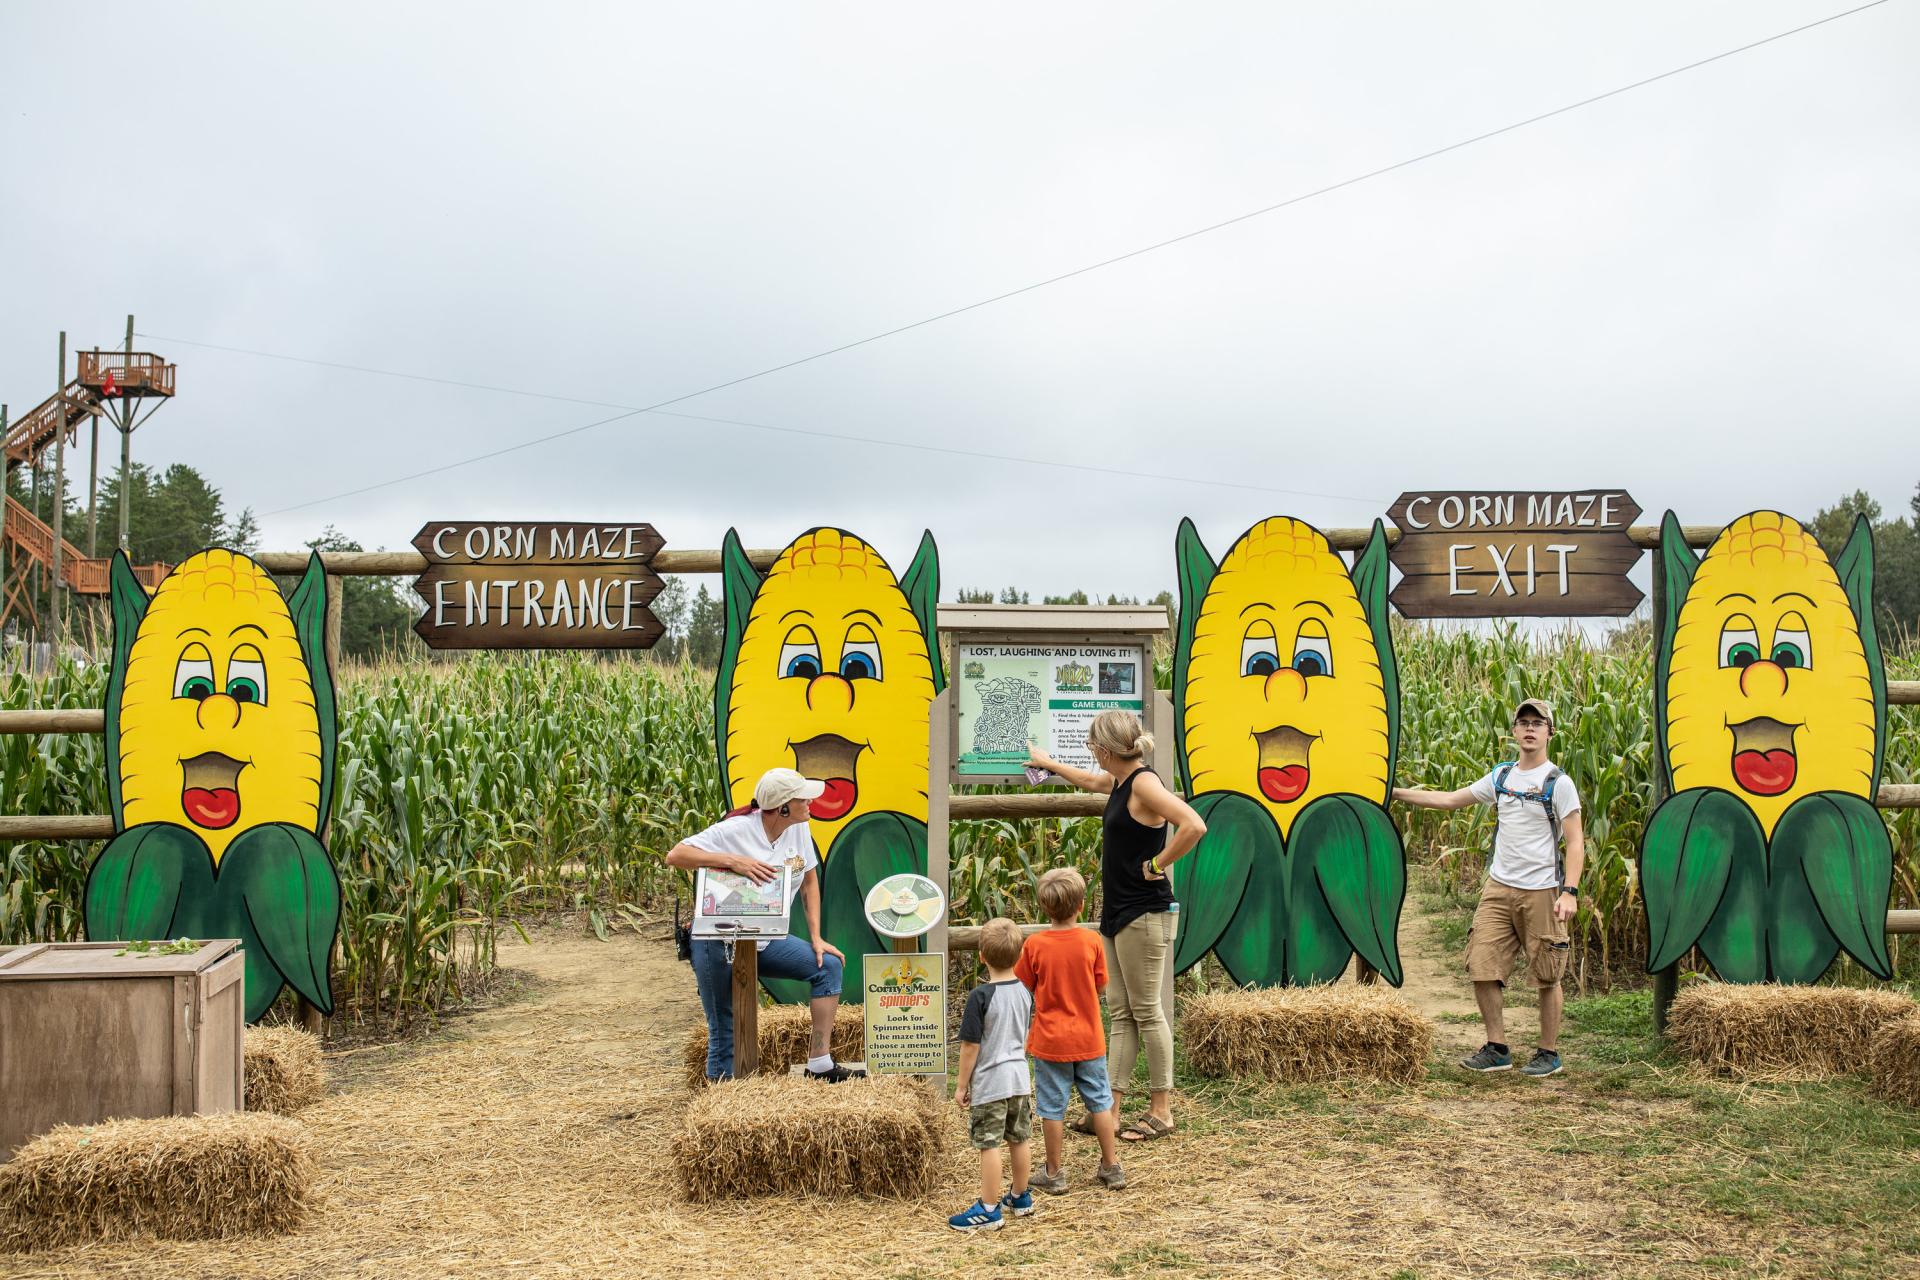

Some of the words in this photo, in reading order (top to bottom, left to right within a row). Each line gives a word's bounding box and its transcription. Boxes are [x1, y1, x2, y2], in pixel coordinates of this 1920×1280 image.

[1406, 494, 1514, 529] CORN
[1526, 494, 1624, 528] MAZE
[432, 526, 537, 560] CORN
[550, 526, 646, 560] MAZE
[1448, 544, 1578, 597] EXIT
[434, 577, 646, 630] ENTRANCE
[970, 648, 997, 657] LOST,
[1000, 648, 1052, 657] LAUGHING
[1054, 648, 1076, 657] AND
[1080, 648, 1116, 657] LOVING
[1118, 648, 1131, 657] IT!
[868, 984, 910, 993] Corny's
[913, 983, 940, 992] Maze
[880, 994, 930, 1008] spinners
[914, 1060, 935, 1068] spin!
